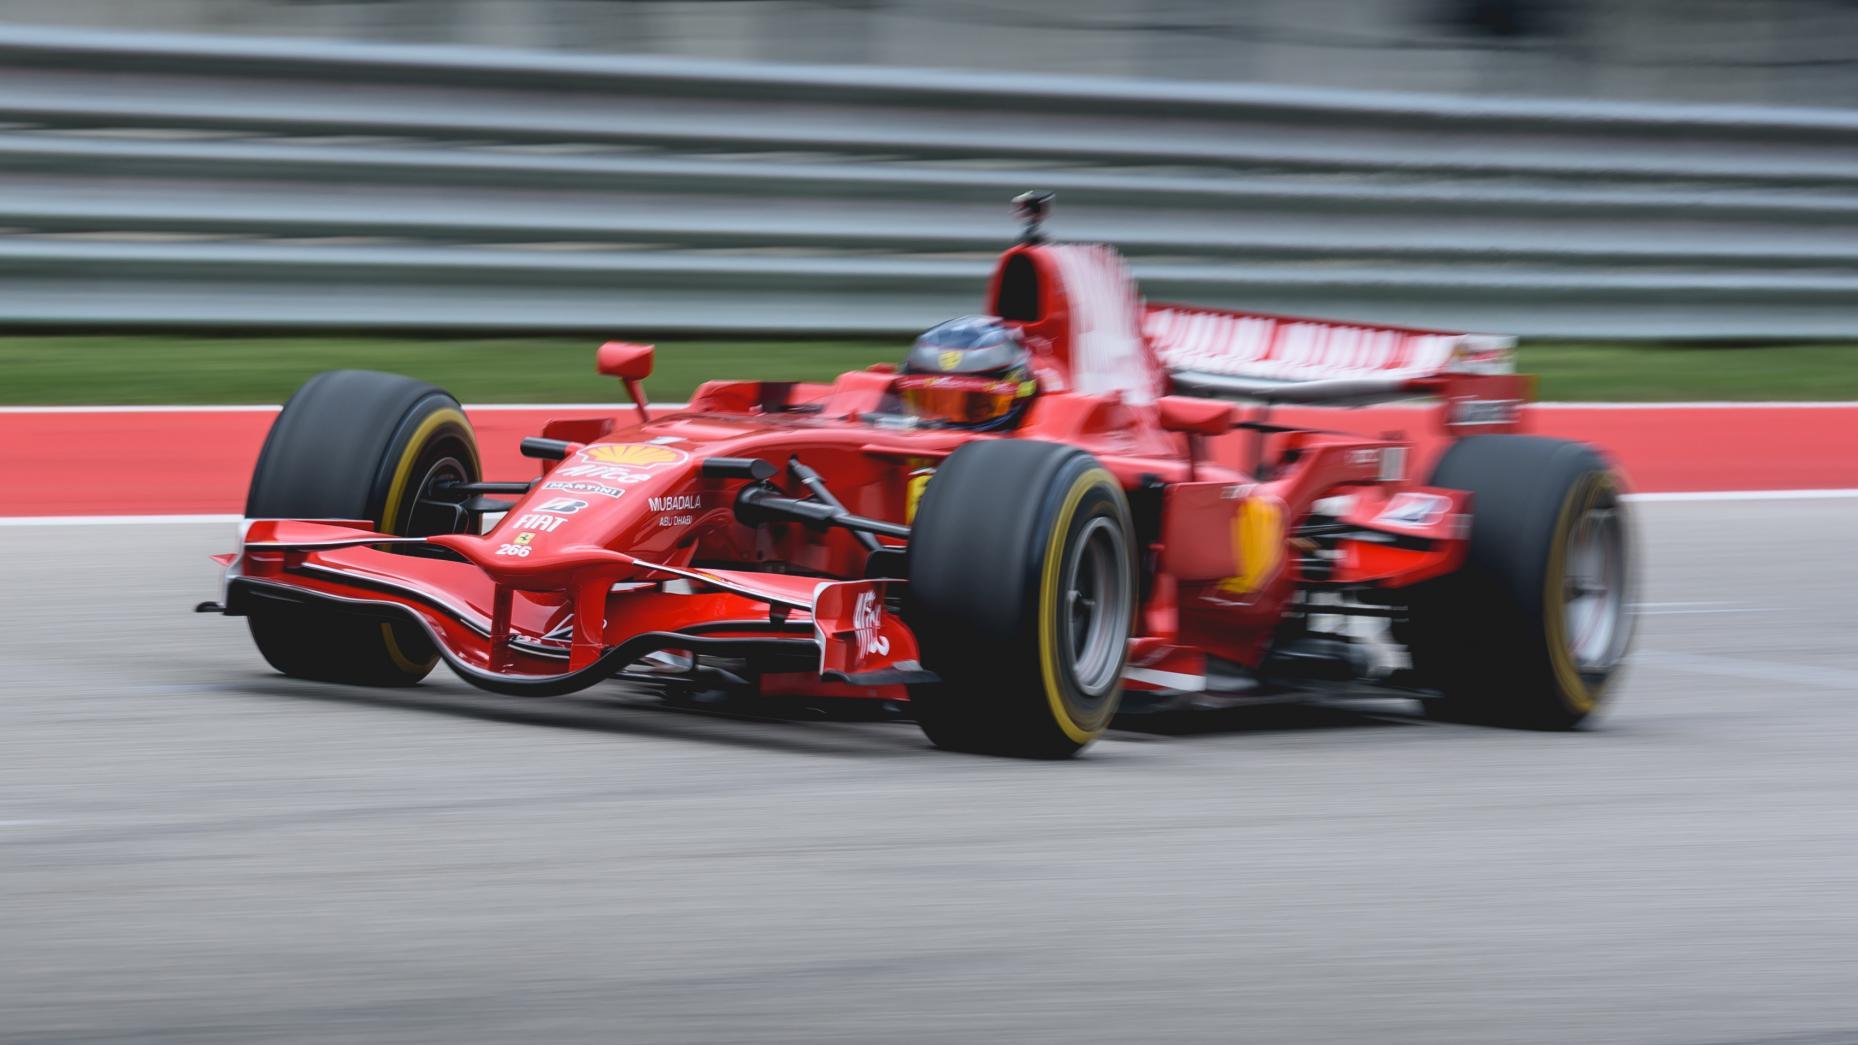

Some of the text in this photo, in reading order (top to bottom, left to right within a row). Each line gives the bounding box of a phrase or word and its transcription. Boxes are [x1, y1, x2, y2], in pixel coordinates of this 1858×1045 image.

[547, 481, 620, 497] MARTINI
[648, 495, 702, 511] MUBADALA
[512, 513, 568, 532] FIAT
[496, 543, 532, 558] 266
